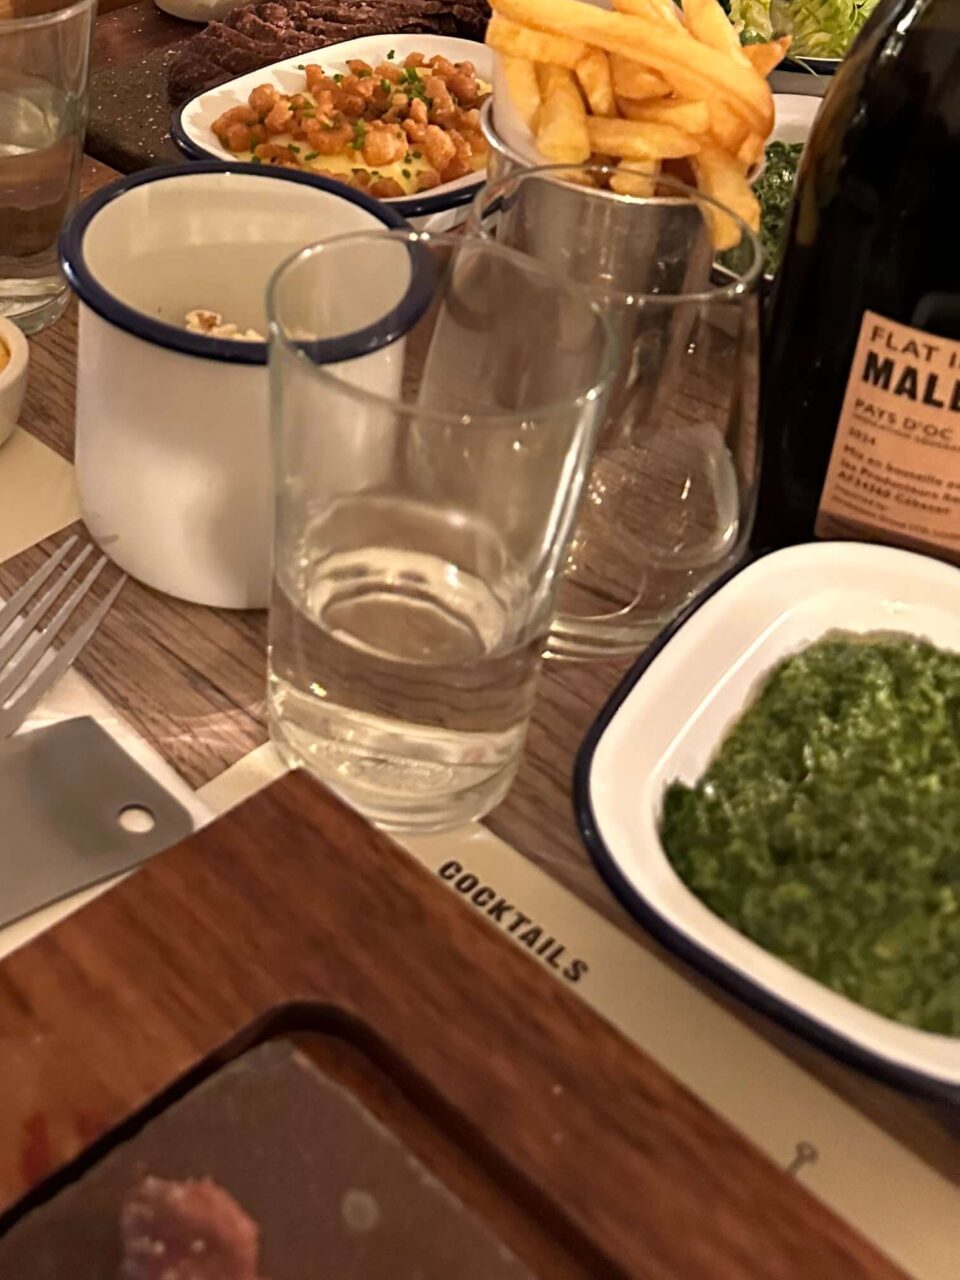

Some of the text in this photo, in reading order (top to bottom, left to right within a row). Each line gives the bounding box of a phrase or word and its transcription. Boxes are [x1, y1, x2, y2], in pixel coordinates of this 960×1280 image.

[871, 325, 960, 369] FLAT I
[854, 398, 896, 424] PAYS
[903, 417, 952, 439] D'OC
[438, 860, 588, 982] COCKTAILS
